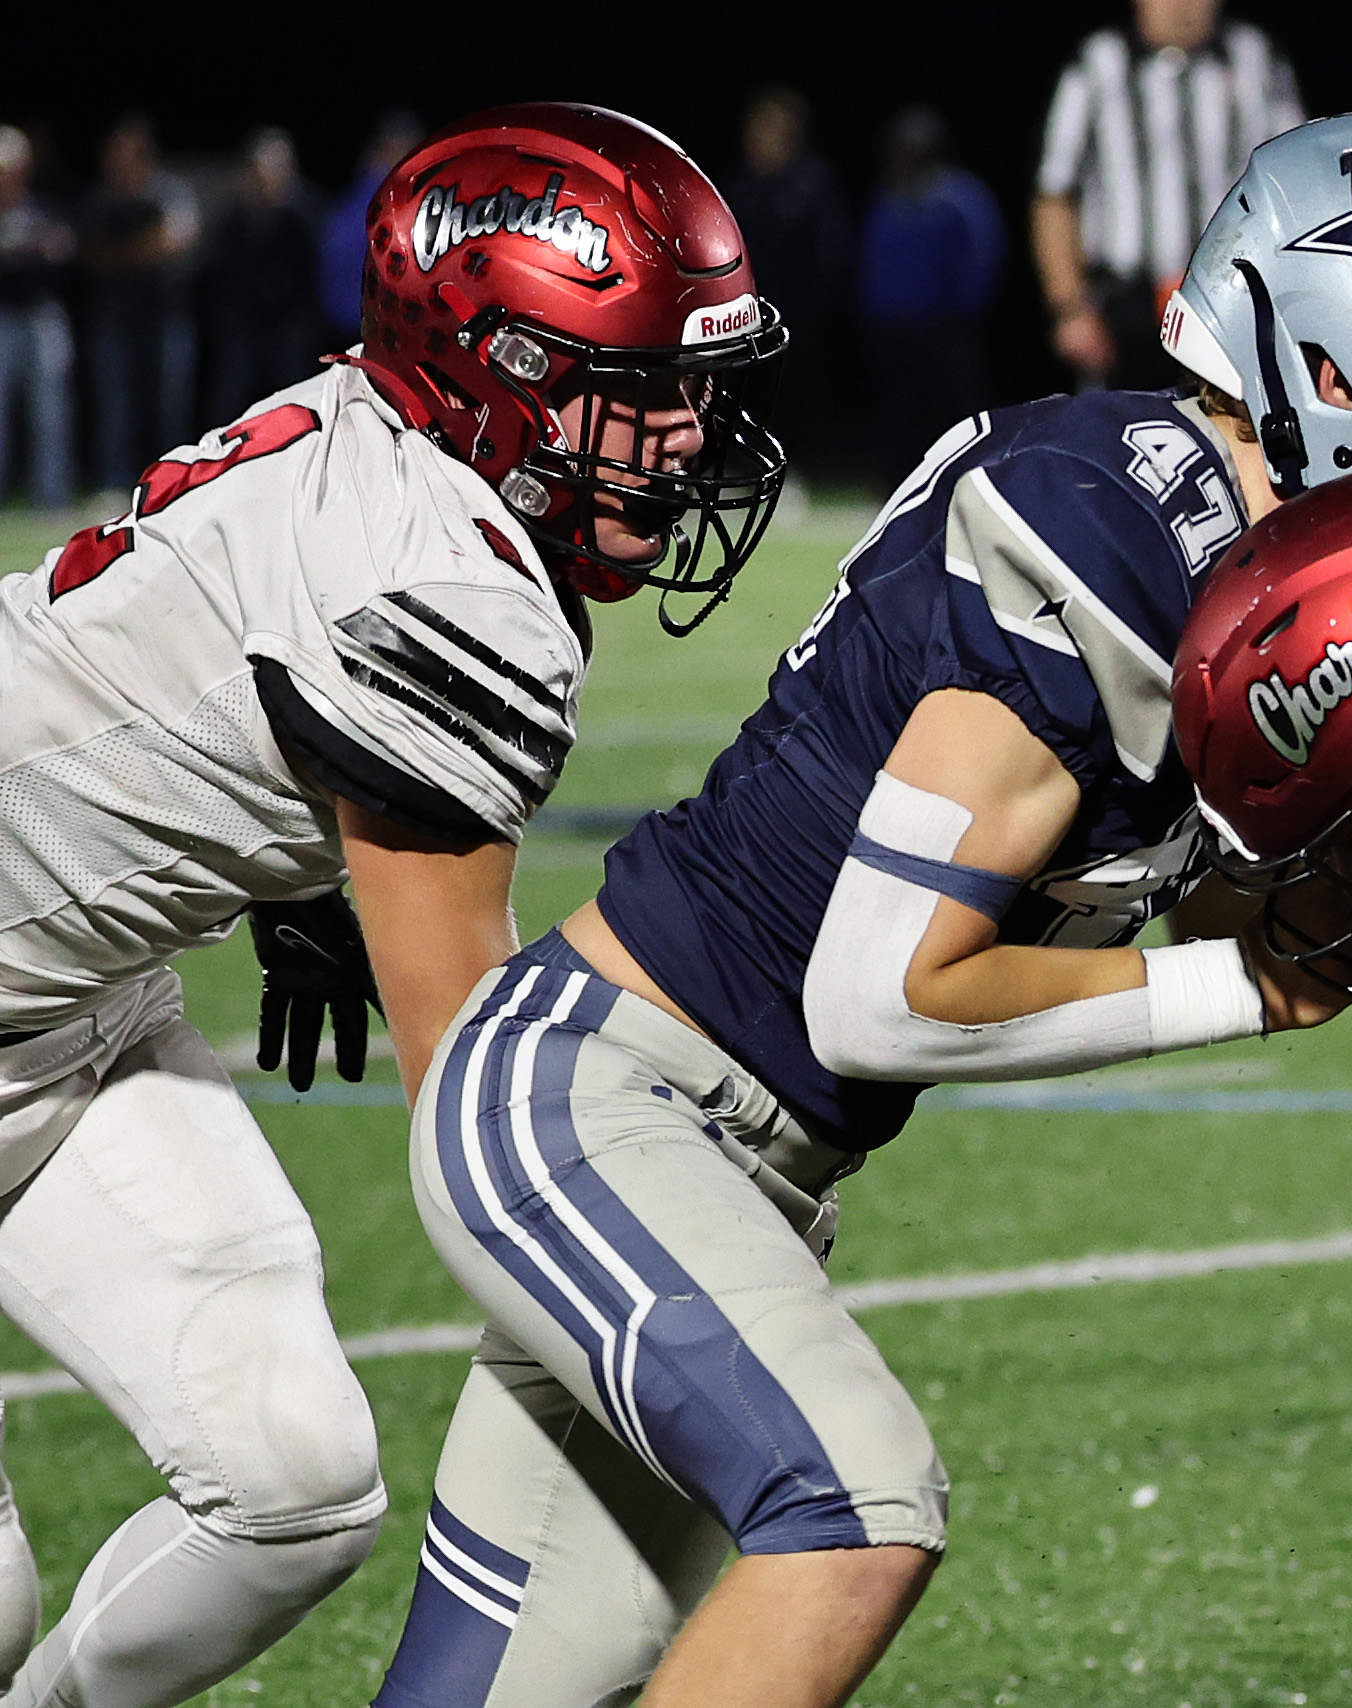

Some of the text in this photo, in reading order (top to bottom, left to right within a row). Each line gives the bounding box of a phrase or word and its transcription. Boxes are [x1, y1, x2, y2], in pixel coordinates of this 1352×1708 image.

[412, 173, 612, 272] Chardon
[700, 301, 757, 338] Riddell
[1121, 419, 1243, 578] 47
